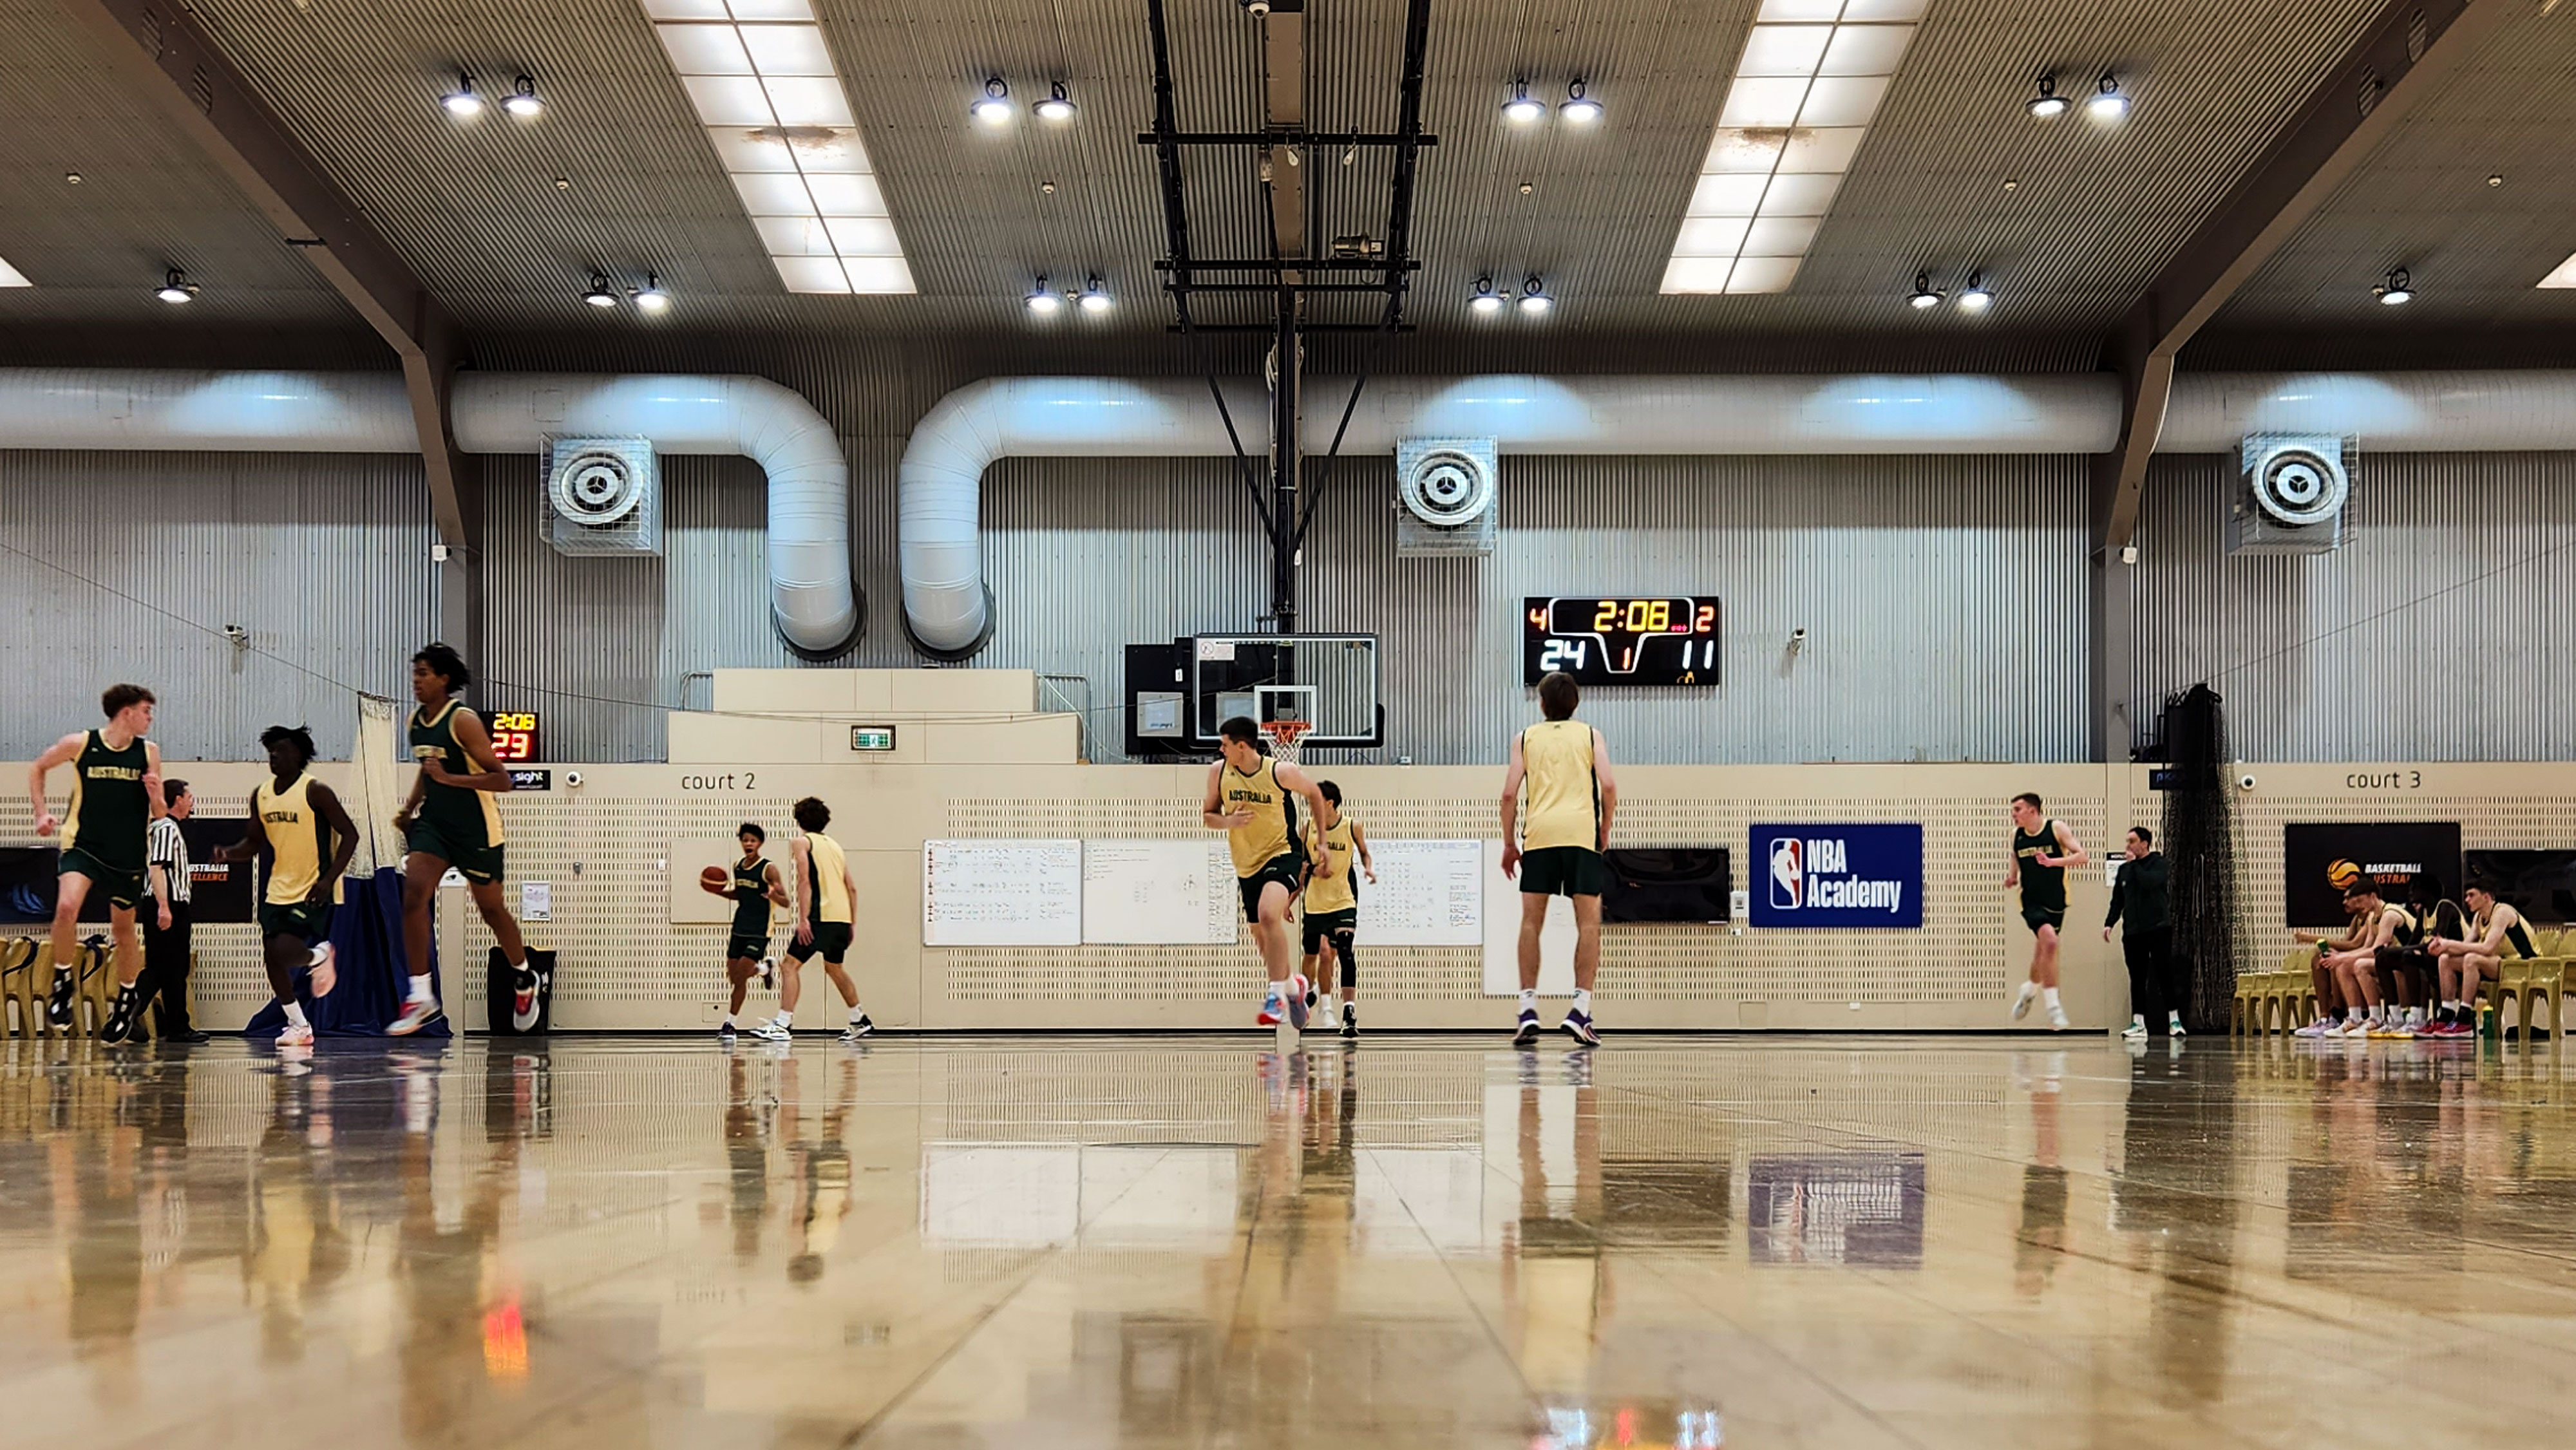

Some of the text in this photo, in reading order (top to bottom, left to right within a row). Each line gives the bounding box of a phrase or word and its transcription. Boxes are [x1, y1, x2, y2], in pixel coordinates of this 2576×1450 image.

[1530, 608, 1547, 631] 4
[1594, 601, 1669, 632] 2:08
[1696, 606, 1714, 632] 2
[1540, 639, 1586, 671] 24
[1623, 647, 1631, 670] 1
[1682, 640, 1714, 669] 11
[493, 713, 535, 730] 2:08
[682, 772, 755, 789] court 2
[2347, 771, 2421, 789] court 3
[1229, 789, 1272, 804] AUSTRALIA
[189, 863, 229, 872] USTRALIA
[1806, 839, 1847, 873] NBA
[2364, 863, 2422, 874] BASKETBALL
[1806, 874, 1902, 913] Academy
